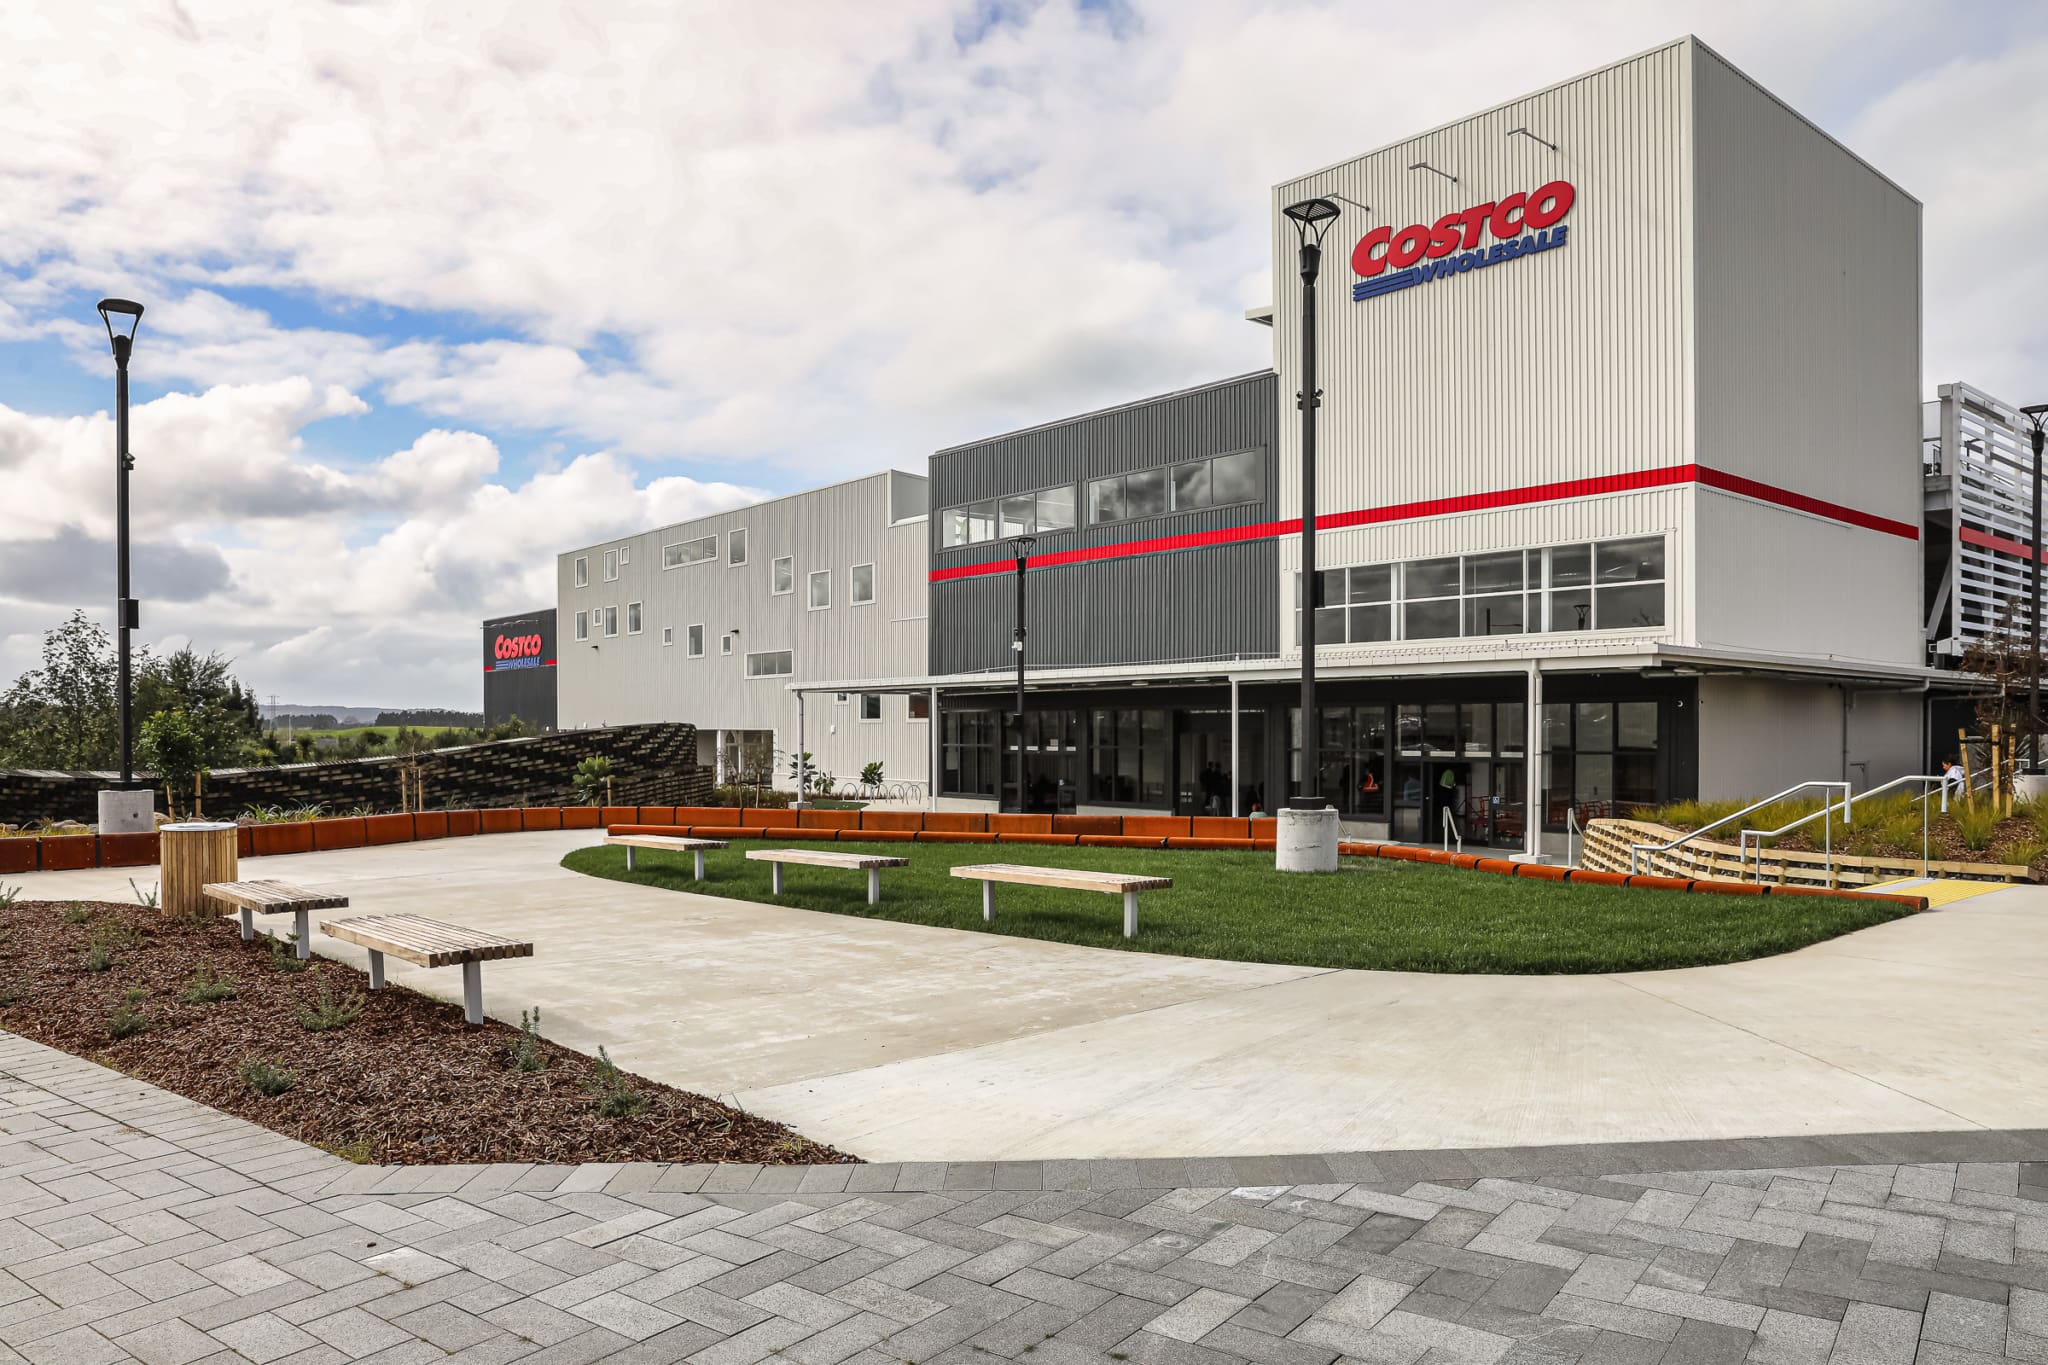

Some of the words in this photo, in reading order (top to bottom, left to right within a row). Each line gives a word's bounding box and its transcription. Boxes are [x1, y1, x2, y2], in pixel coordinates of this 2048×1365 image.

[1352, 180, 1575, 277] COSTCO
[1411, 225, 1568, 285] WHOLESALE
[494, 634, 542, 659] COSTCO
